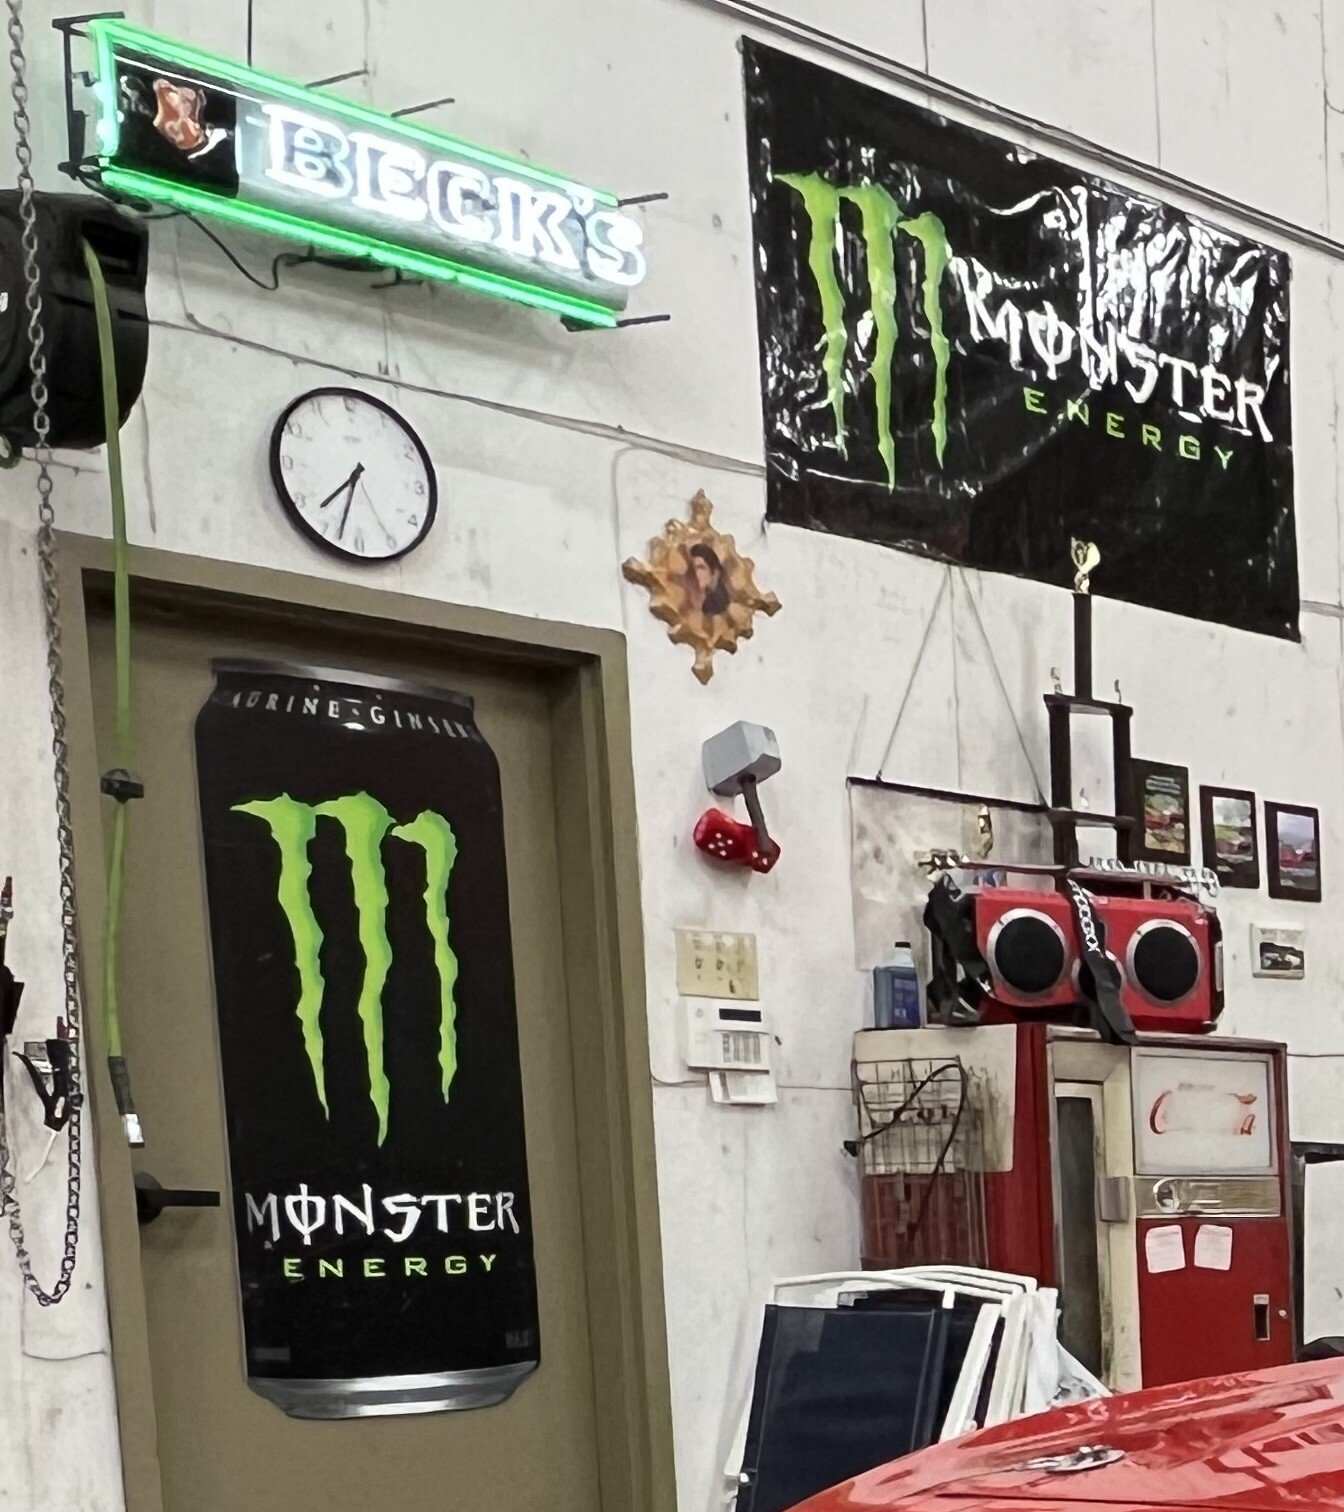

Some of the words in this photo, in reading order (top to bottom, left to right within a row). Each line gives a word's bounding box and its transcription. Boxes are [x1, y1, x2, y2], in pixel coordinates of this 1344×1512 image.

[259, 102, 649, 289] BECK'S
[948, 256, 1274, 444] MONSTER
[1023, 387, 1234, 470] ENERGY
[245, 1183, 521, 1246] MONSTER
[282, 1253, 497, 1279] ENERGY
